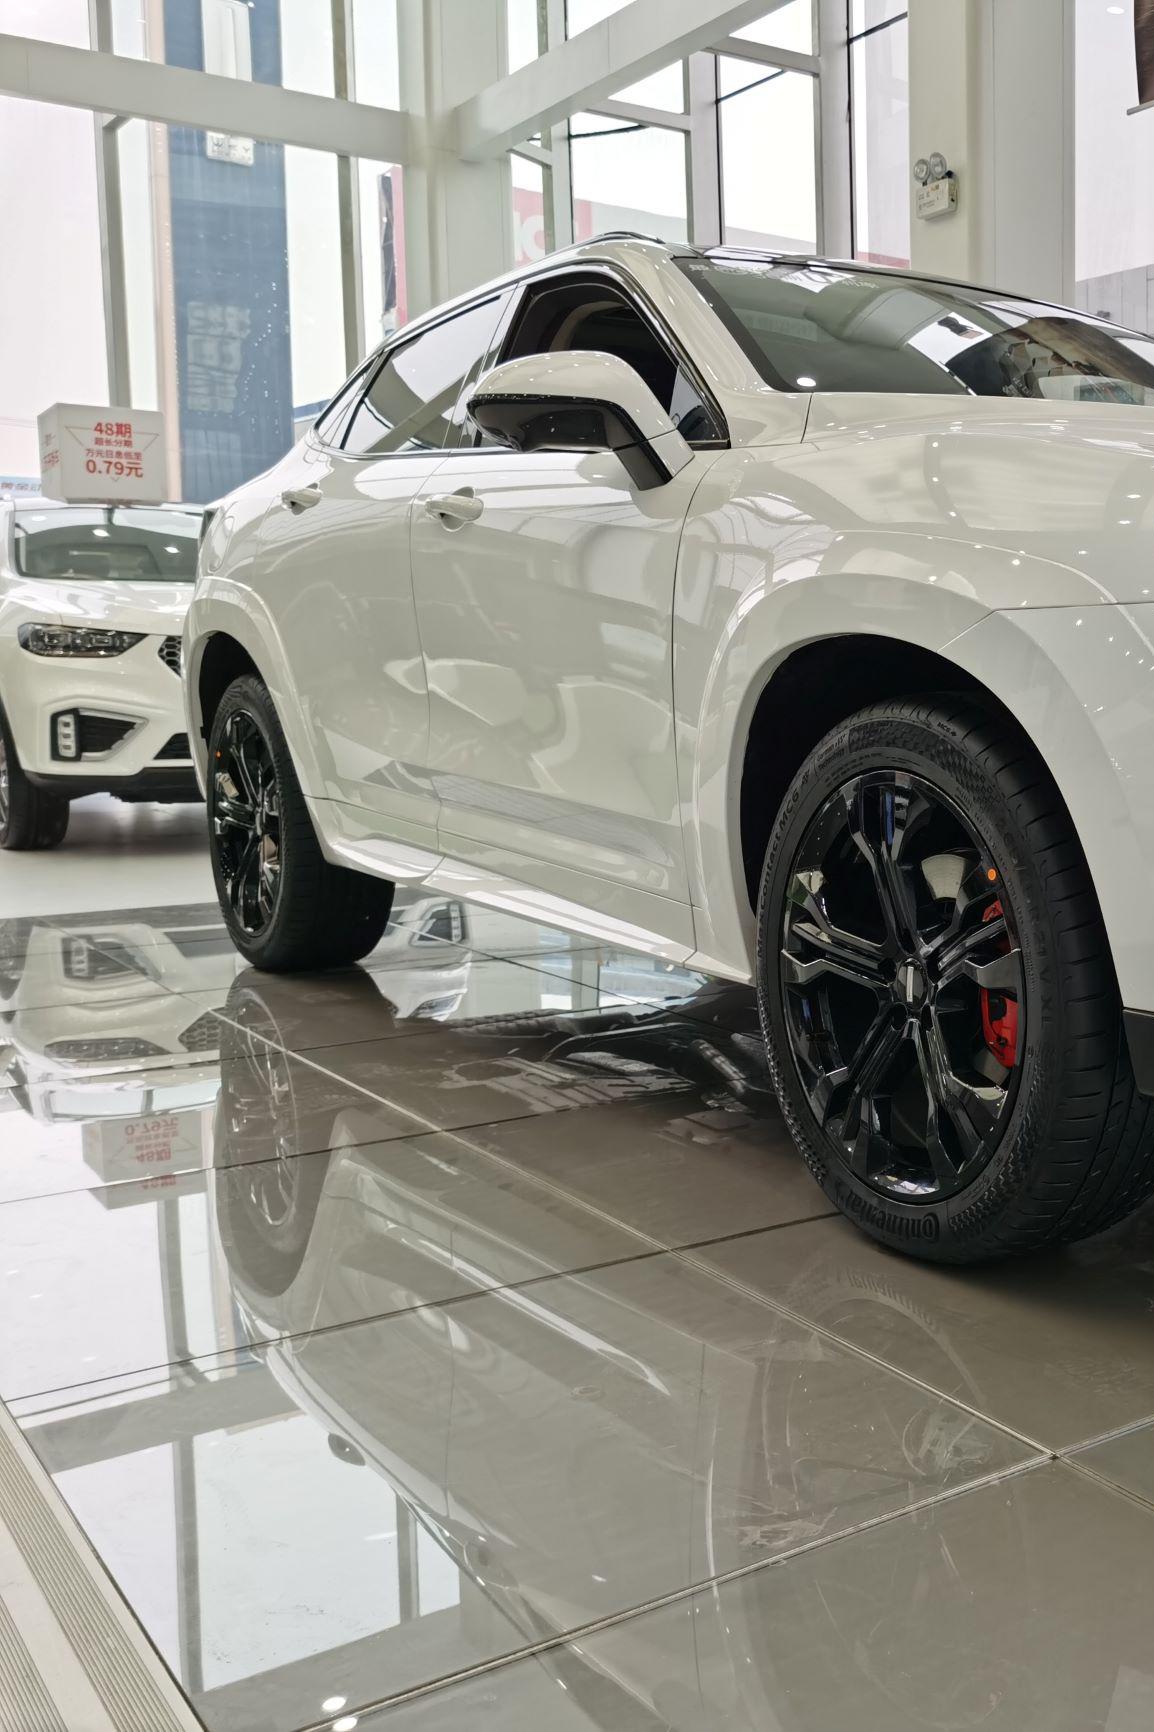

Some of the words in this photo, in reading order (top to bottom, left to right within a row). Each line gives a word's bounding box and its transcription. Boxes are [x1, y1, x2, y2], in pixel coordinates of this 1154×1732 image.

[94, 422, 133, 438] 48期
[86, 459, 144, 478] 0.79元
[844, 1190, 940, 1241] Continental
